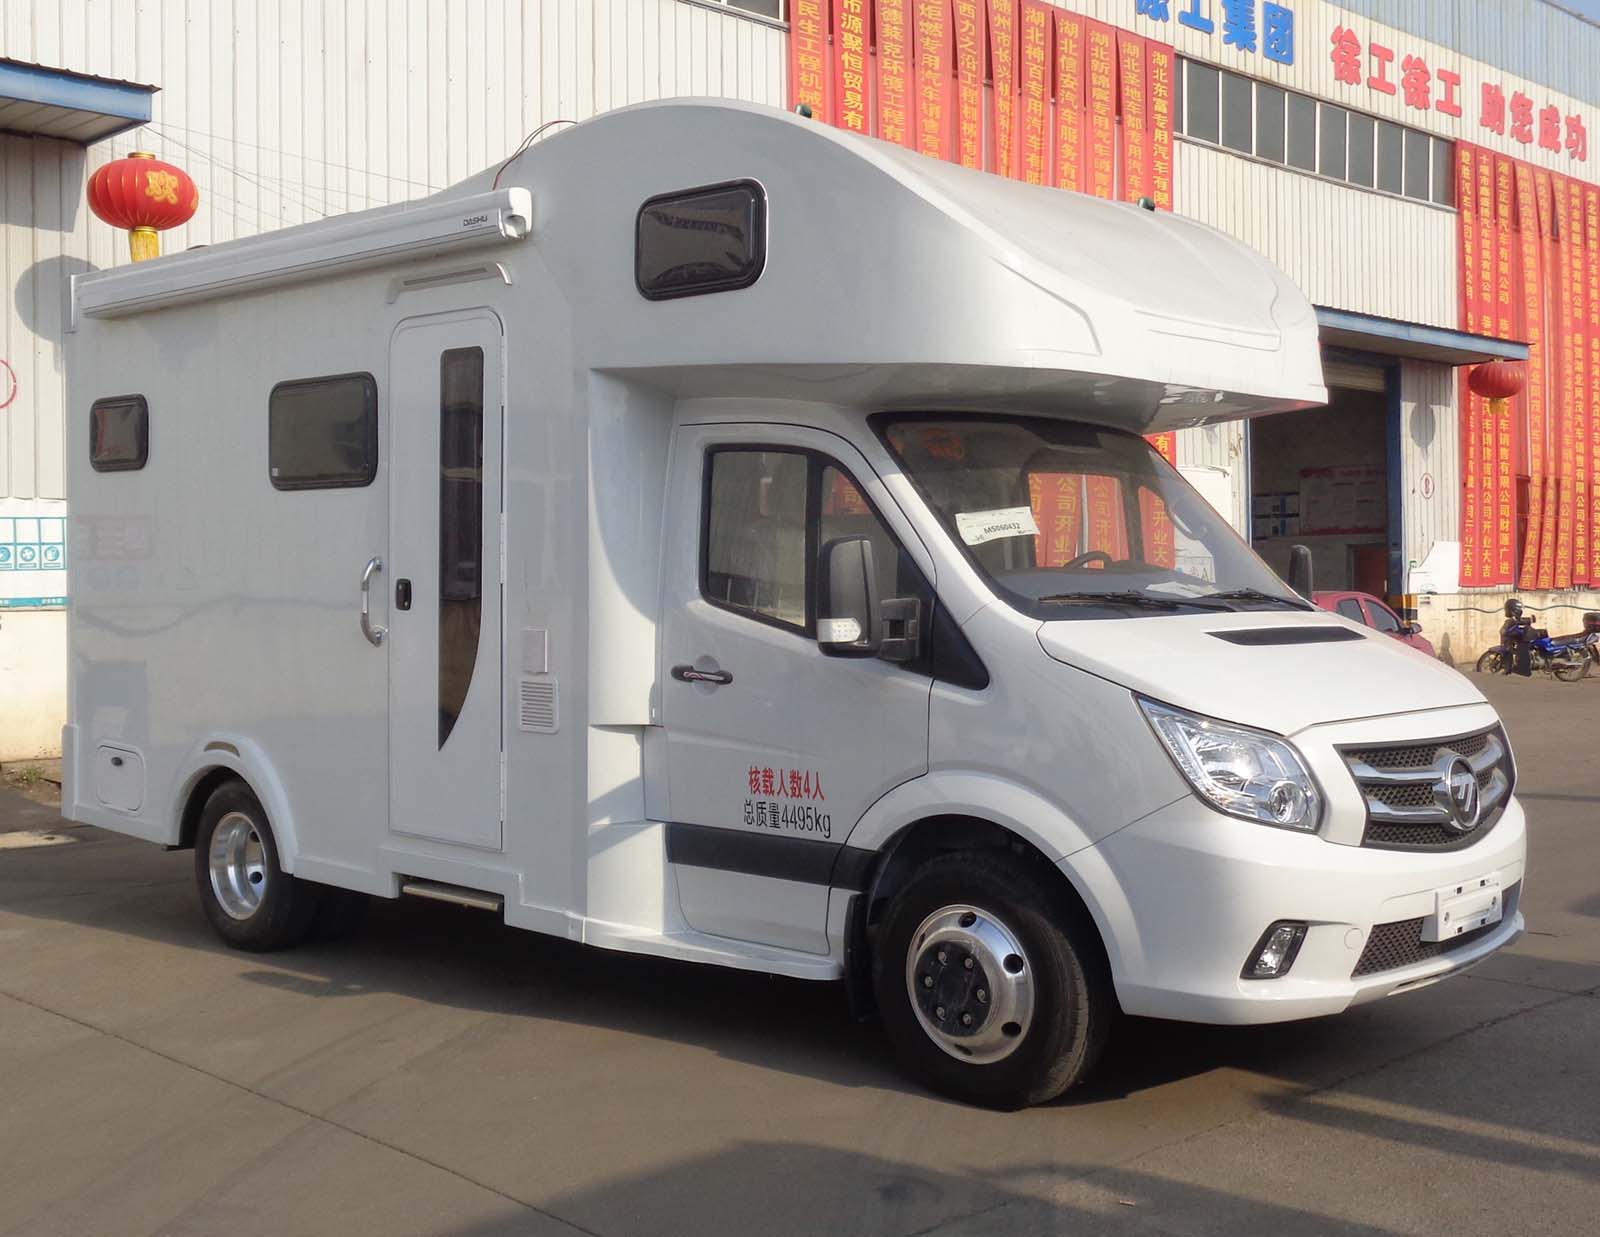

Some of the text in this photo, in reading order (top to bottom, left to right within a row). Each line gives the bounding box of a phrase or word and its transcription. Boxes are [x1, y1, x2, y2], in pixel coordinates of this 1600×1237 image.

[1330, 24, 1588, 162] 徐工徐工 助您成功
[748, 766, 825, 801] 核载人数4人
[743, 799, 831, 839] 总质量4495kg
